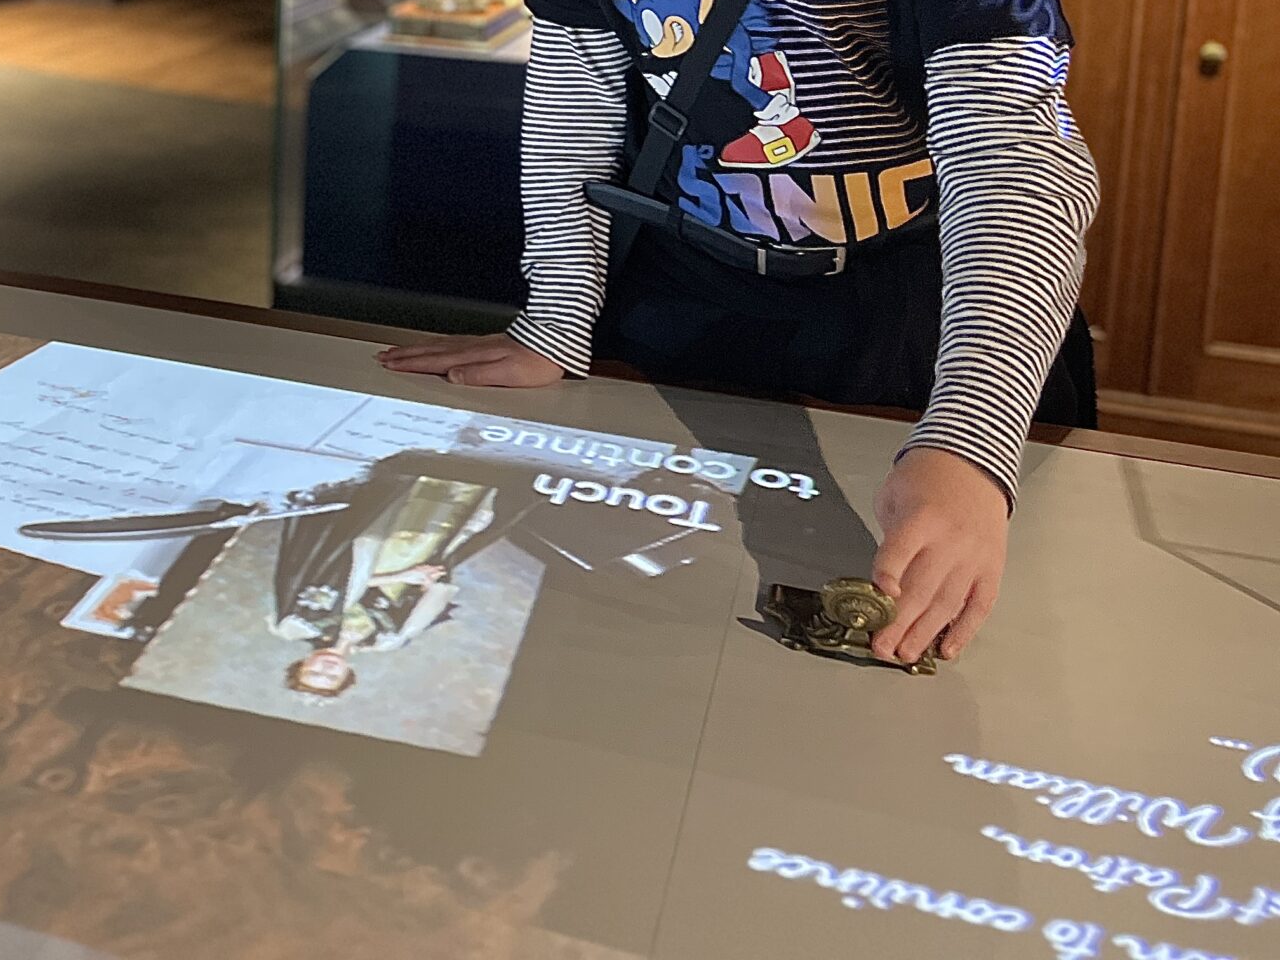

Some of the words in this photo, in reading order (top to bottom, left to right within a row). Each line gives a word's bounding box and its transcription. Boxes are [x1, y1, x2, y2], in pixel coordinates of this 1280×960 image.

[677, 144, 933, 243] SONIC
[479, 424, 741, 481] continue
[533, 473, 722, 532] Touch
[749, 467, 821, 500] to
[942, 752, 1253, 847] William
[747, 846, 1035, 931] convince
[1041, 918, 1107, 960] to
